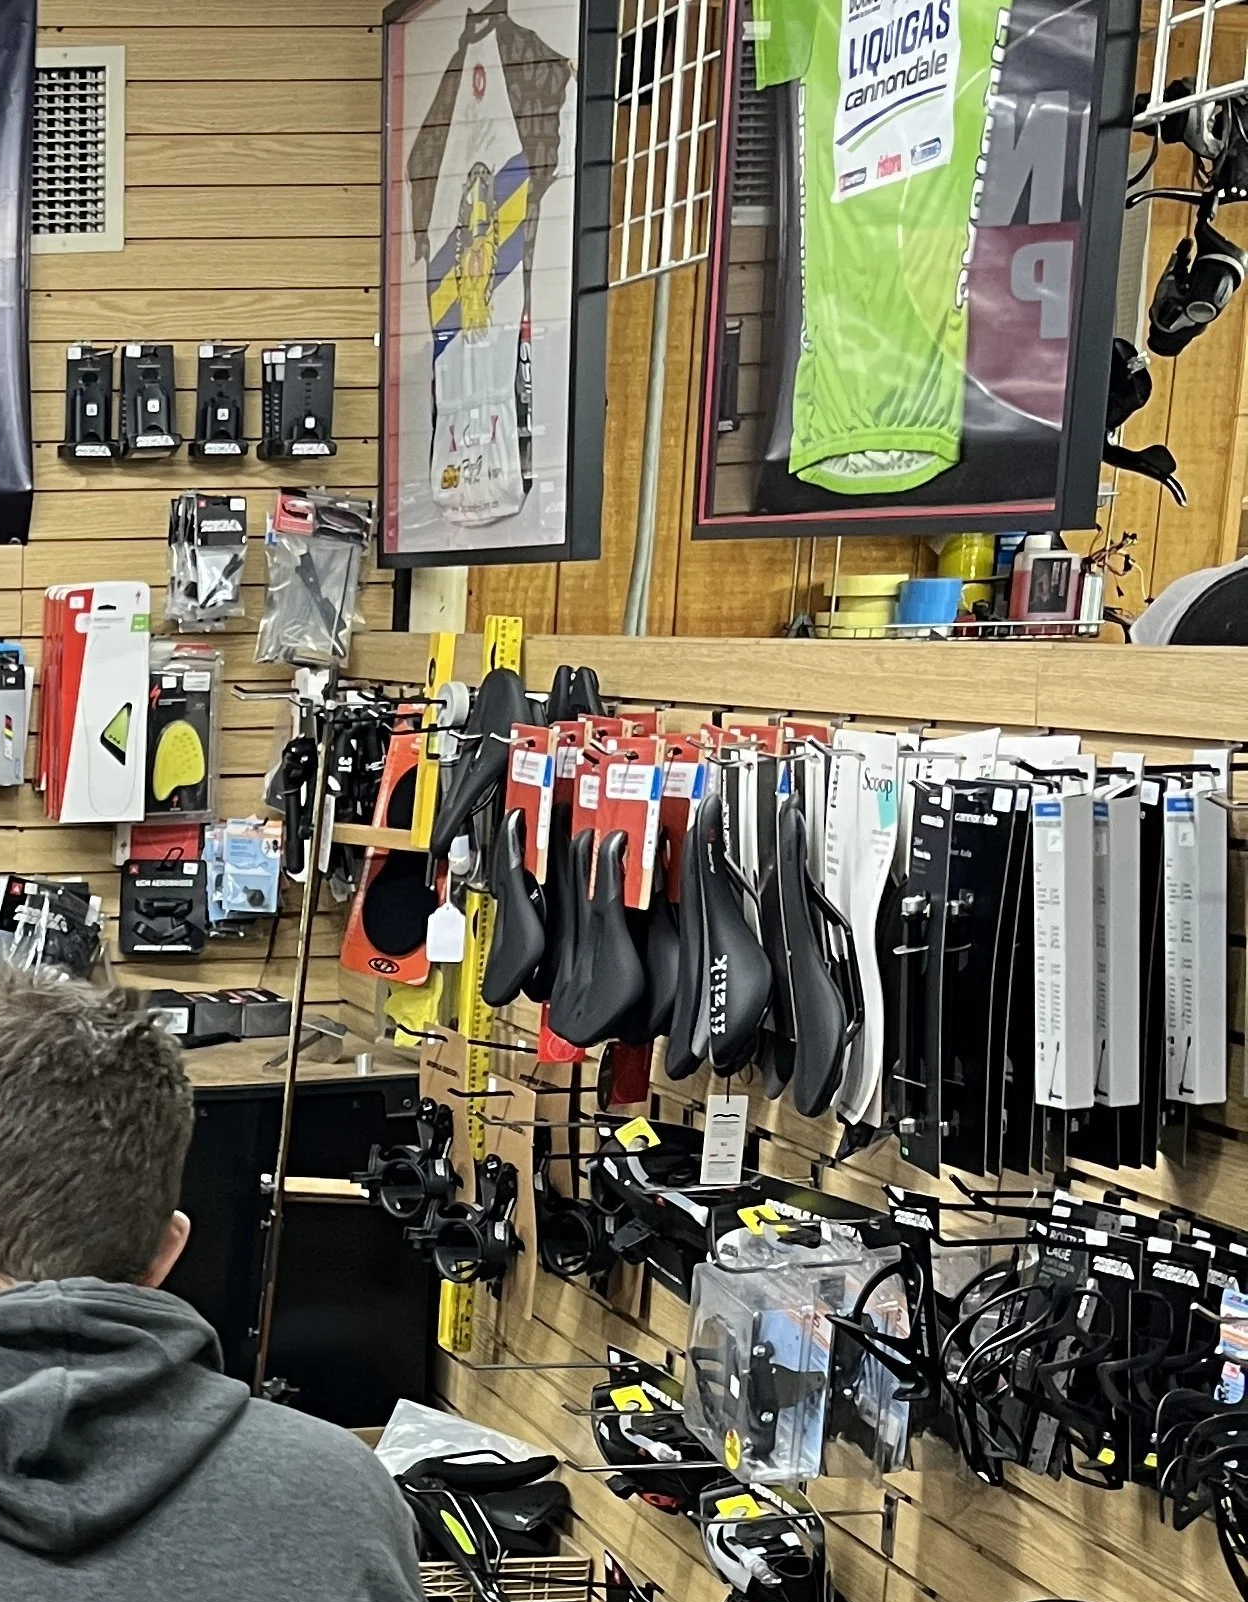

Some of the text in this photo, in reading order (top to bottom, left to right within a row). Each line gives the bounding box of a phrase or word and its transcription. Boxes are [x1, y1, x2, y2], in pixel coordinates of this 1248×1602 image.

[848, 0, 951, 80] LIQUIGAS
[844, 50, 949, 113] cannondale
[862, 766, 893, 801] Scoop
[1046, 1246, 1072, 1262] CAGE
